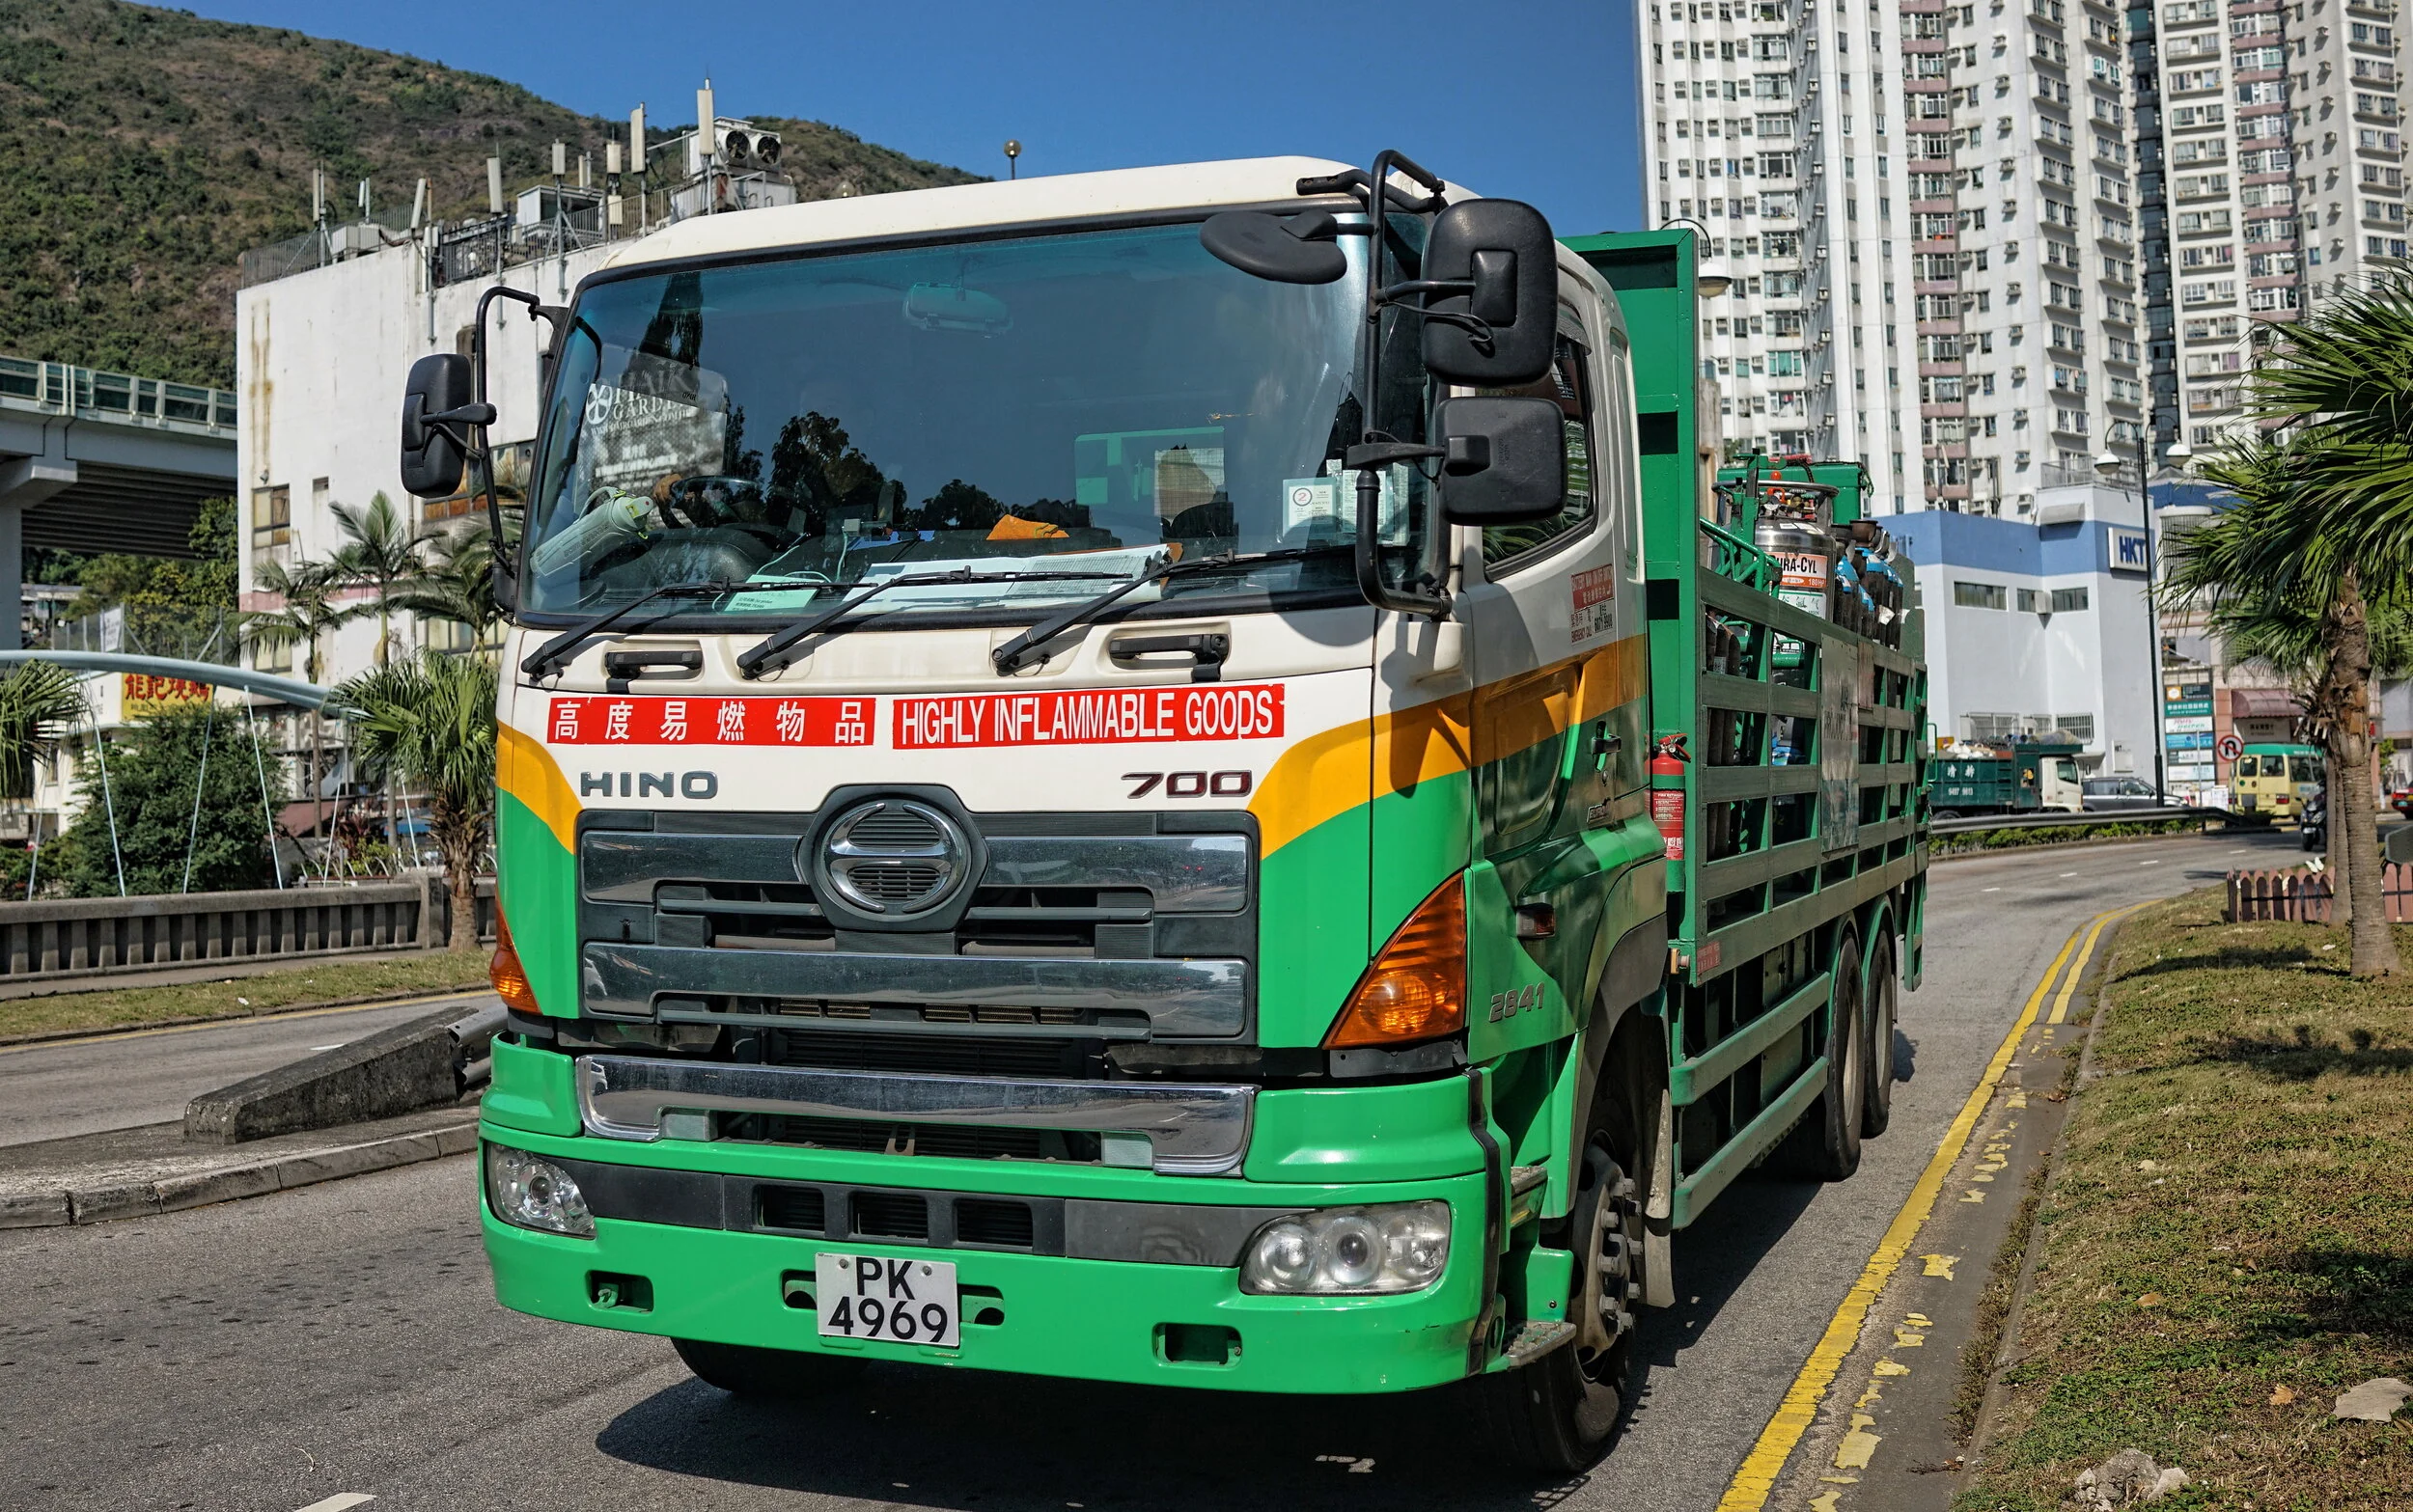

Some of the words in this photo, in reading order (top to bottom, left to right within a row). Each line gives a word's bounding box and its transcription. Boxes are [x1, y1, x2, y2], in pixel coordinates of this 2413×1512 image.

[1298, 492, 1307, 502] 2
[2119, 535, 2146, 565] HKT
[554, 701, 866, 744] 高度易燃物品
[902, 699, 986, 745] HIGHLY
[994, 692, 1175, 742] INFLAMMABLE
[1184, 689, 1273, 737] GOODS
[580, 771, 718, 800] HINO
[1120, 770, 1253, 800] 700
[1488, 981, 1545, 1024] 2841
[855, 1256, 916, 1301] PK
[827, 1296, 948, 1343] 4969
